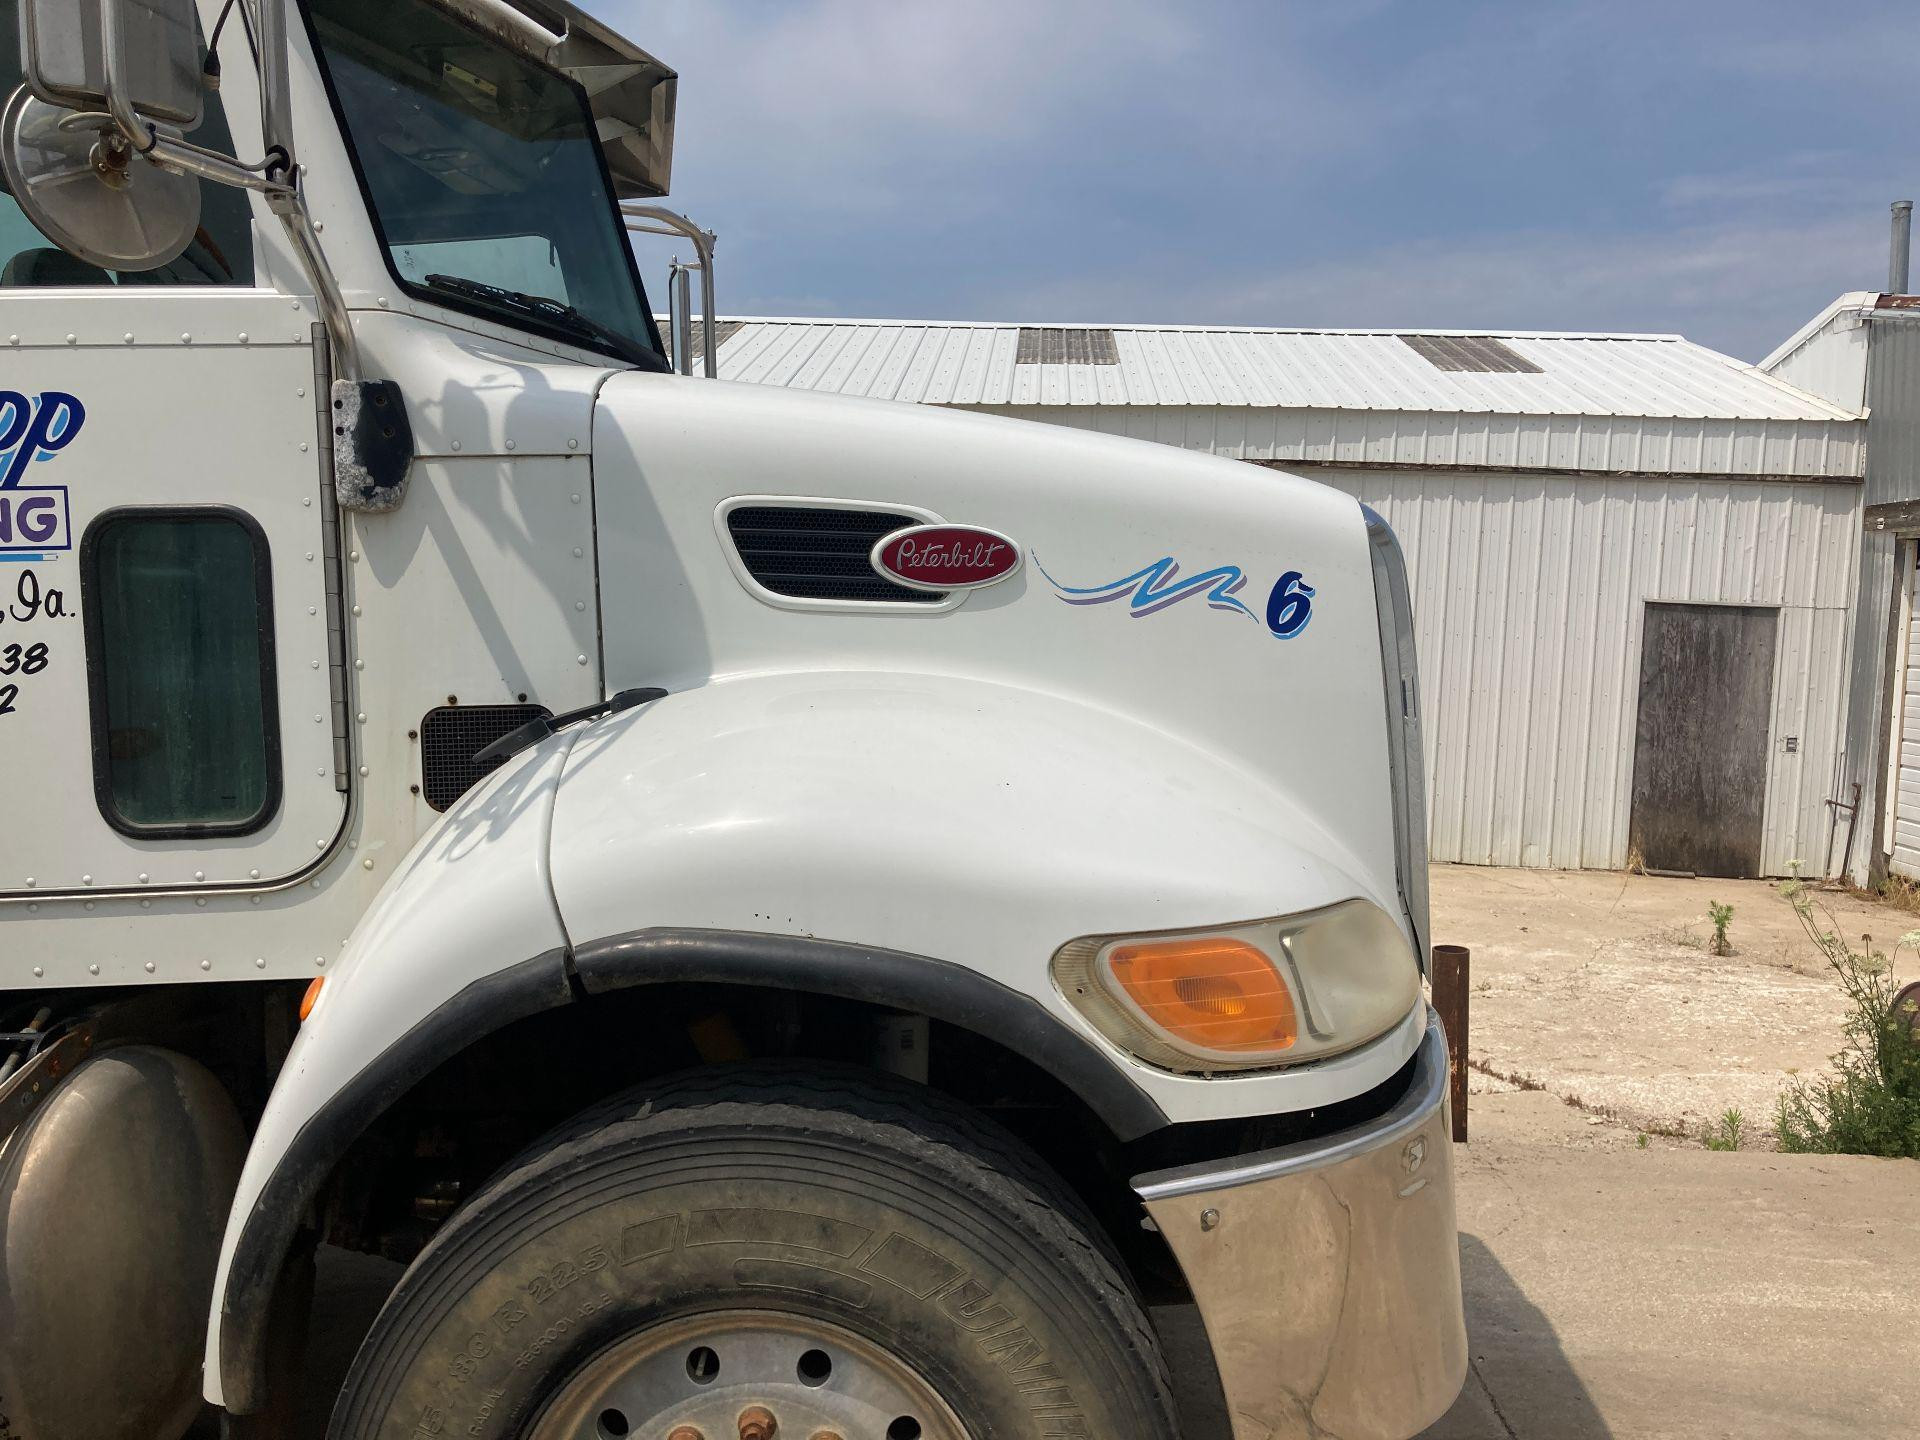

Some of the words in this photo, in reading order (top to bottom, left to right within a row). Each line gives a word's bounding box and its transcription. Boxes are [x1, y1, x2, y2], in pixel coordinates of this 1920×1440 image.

[897, 538, 1005, 570] Peterbilt
[1266, 570, 1316, 640] 6
[0, 643, 49, 675] 38
[0, 684, 19, 715] 2
